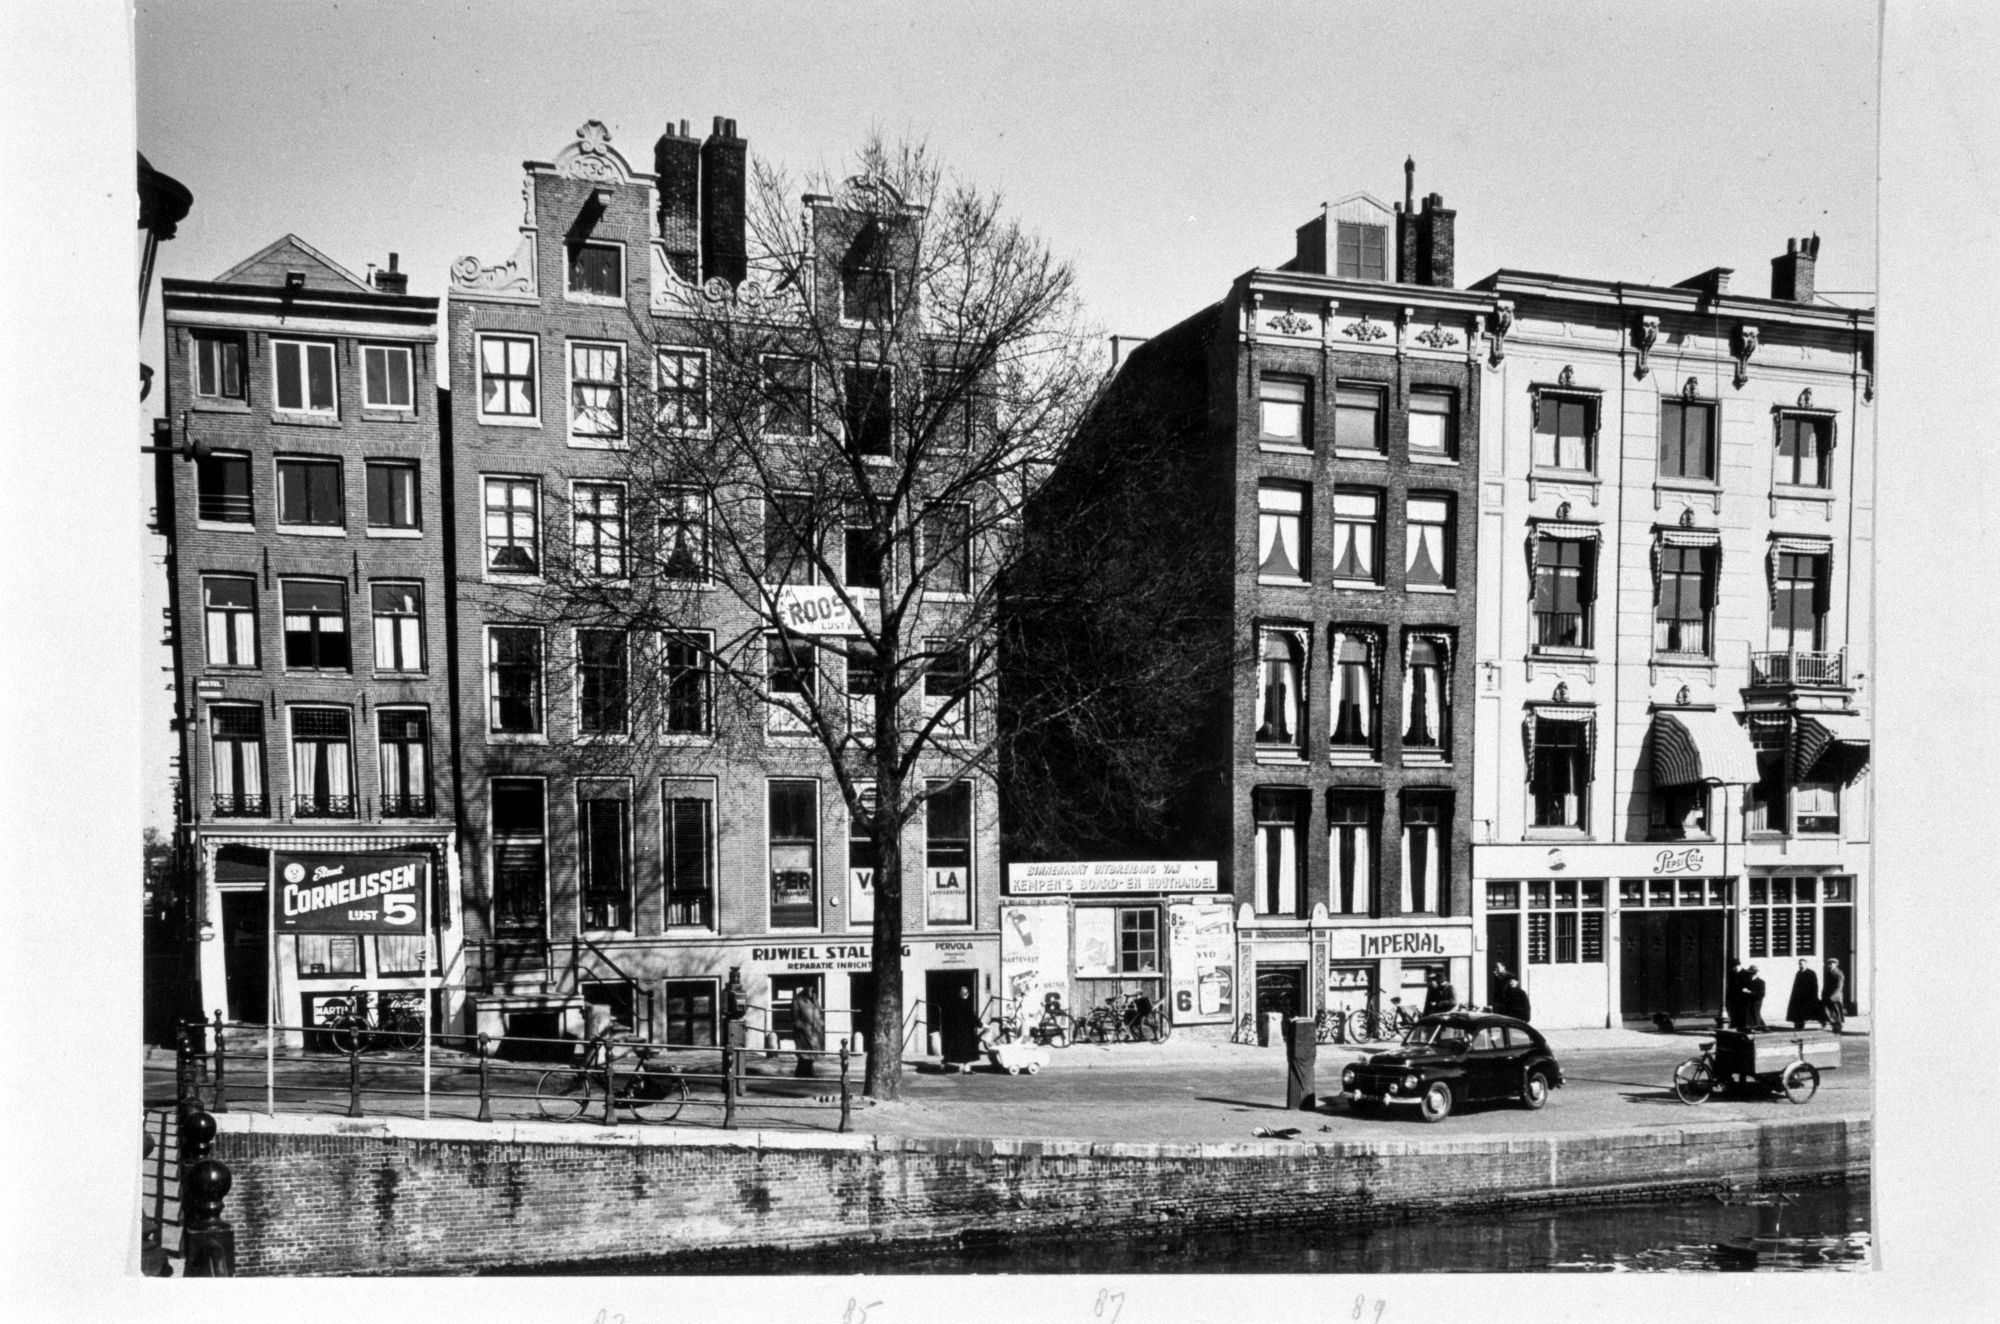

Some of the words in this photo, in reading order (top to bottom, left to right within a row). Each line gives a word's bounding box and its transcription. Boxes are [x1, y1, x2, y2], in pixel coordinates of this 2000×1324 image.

[1026, 864, 1089, 876] BINNENKORT
[1094, 863, 1156, 875] UITBREIDING
[1163, 863, 1181, 875] VAN
[936, 871, 959, 889] LA
[1013, 877, 1074, 892] KEMPEN'S
[1149, 877, 1216, 890] HOUTHANDEL
[284, 863, 416, 916] CORNELISSEN
[383, 893, 417, 926] 5
[935, 942, 973, 950] PERVOLA
[1361, 932, 1445, 957] IMPERIAL
[752, 946, 820, 961] RIJWIEL
[787, 961, 834, 970] REPARATIE
[1177, 990, 1192, 1012] 6
